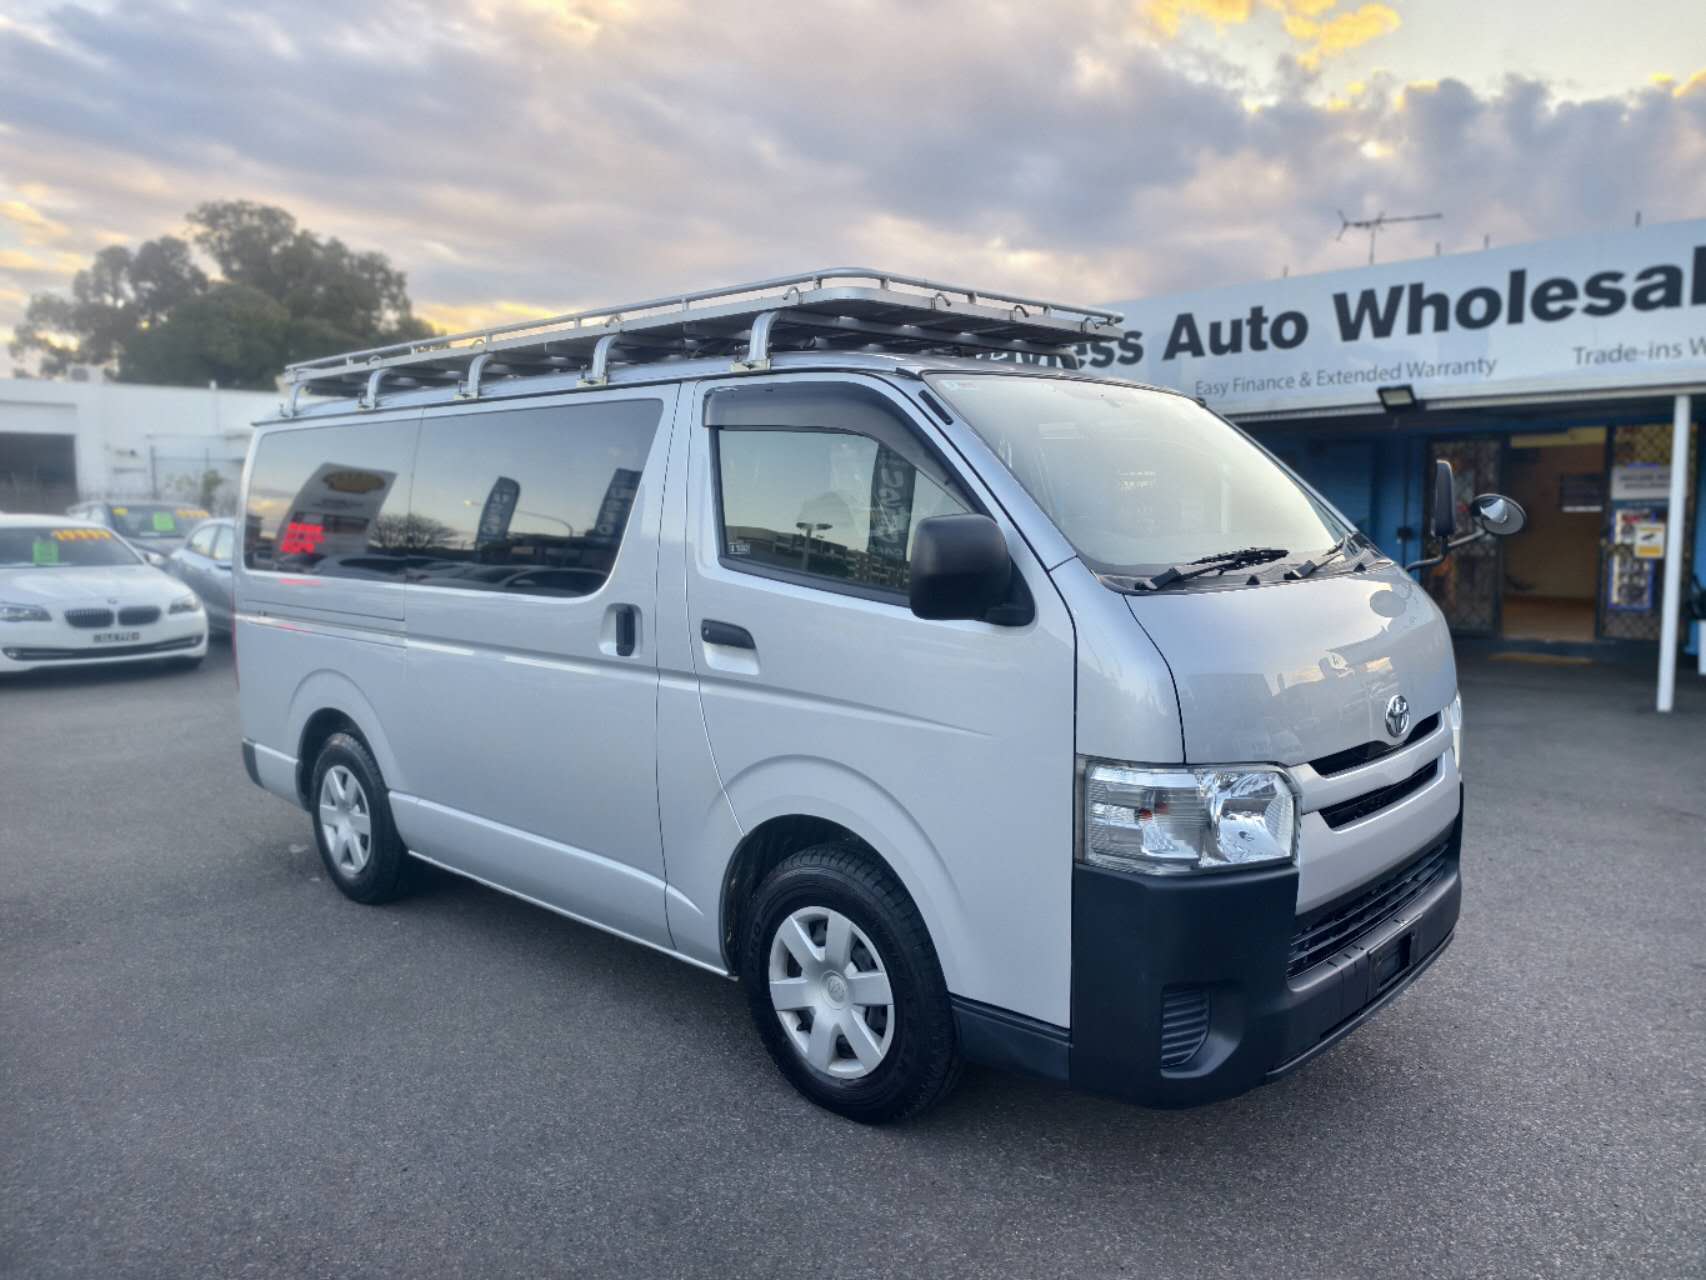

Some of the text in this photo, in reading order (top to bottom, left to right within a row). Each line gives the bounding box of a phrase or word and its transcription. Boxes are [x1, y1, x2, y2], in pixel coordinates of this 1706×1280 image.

[1162, 306, 1309, 361] Auto
[1572, 341, 1683, 365] Trade-ins
[1195, 356, 1497, 399] Easy Finance & Extended Warranty
